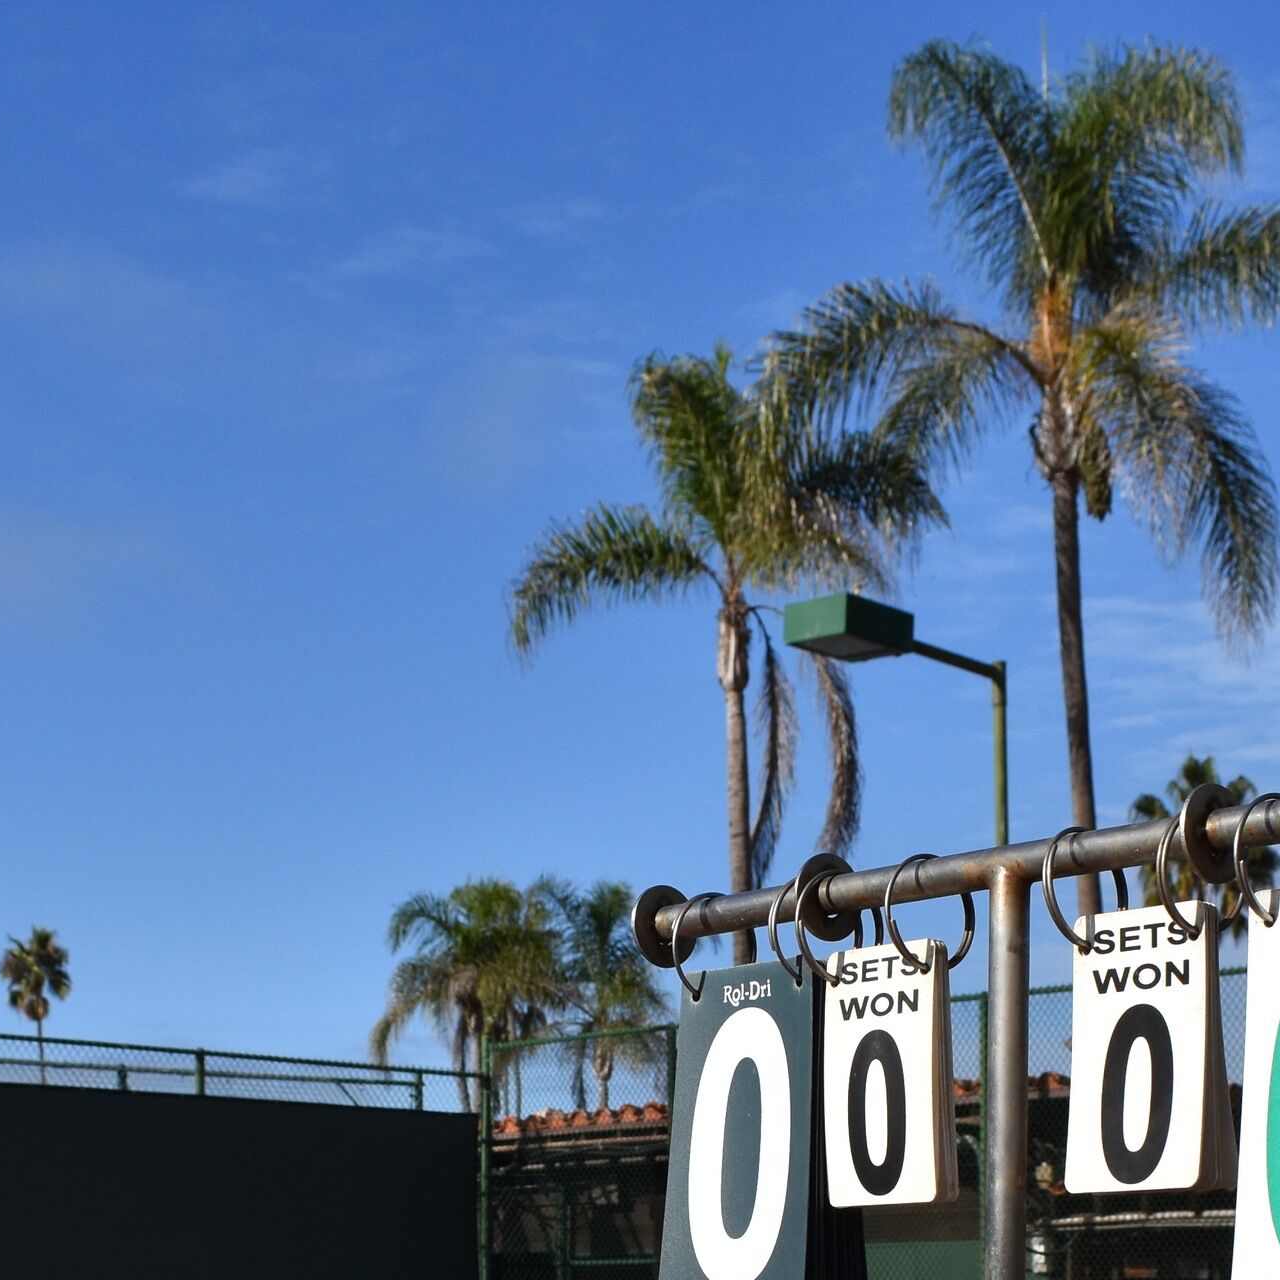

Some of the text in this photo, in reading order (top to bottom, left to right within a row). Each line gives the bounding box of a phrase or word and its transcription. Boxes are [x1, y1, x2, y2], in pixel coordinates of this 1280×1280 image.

[1093, 921, 1189, 955] SETS
[840, 952, 921, 986] SETS
[1092, 959, 1191, 995] WON
[722, 979, 772, 1007] Rol-Dri
[839, 988, 920, 1021] WON
[1101, 1003, 1174, 1185] 0
[847, 1029, 907, 1196] 0
